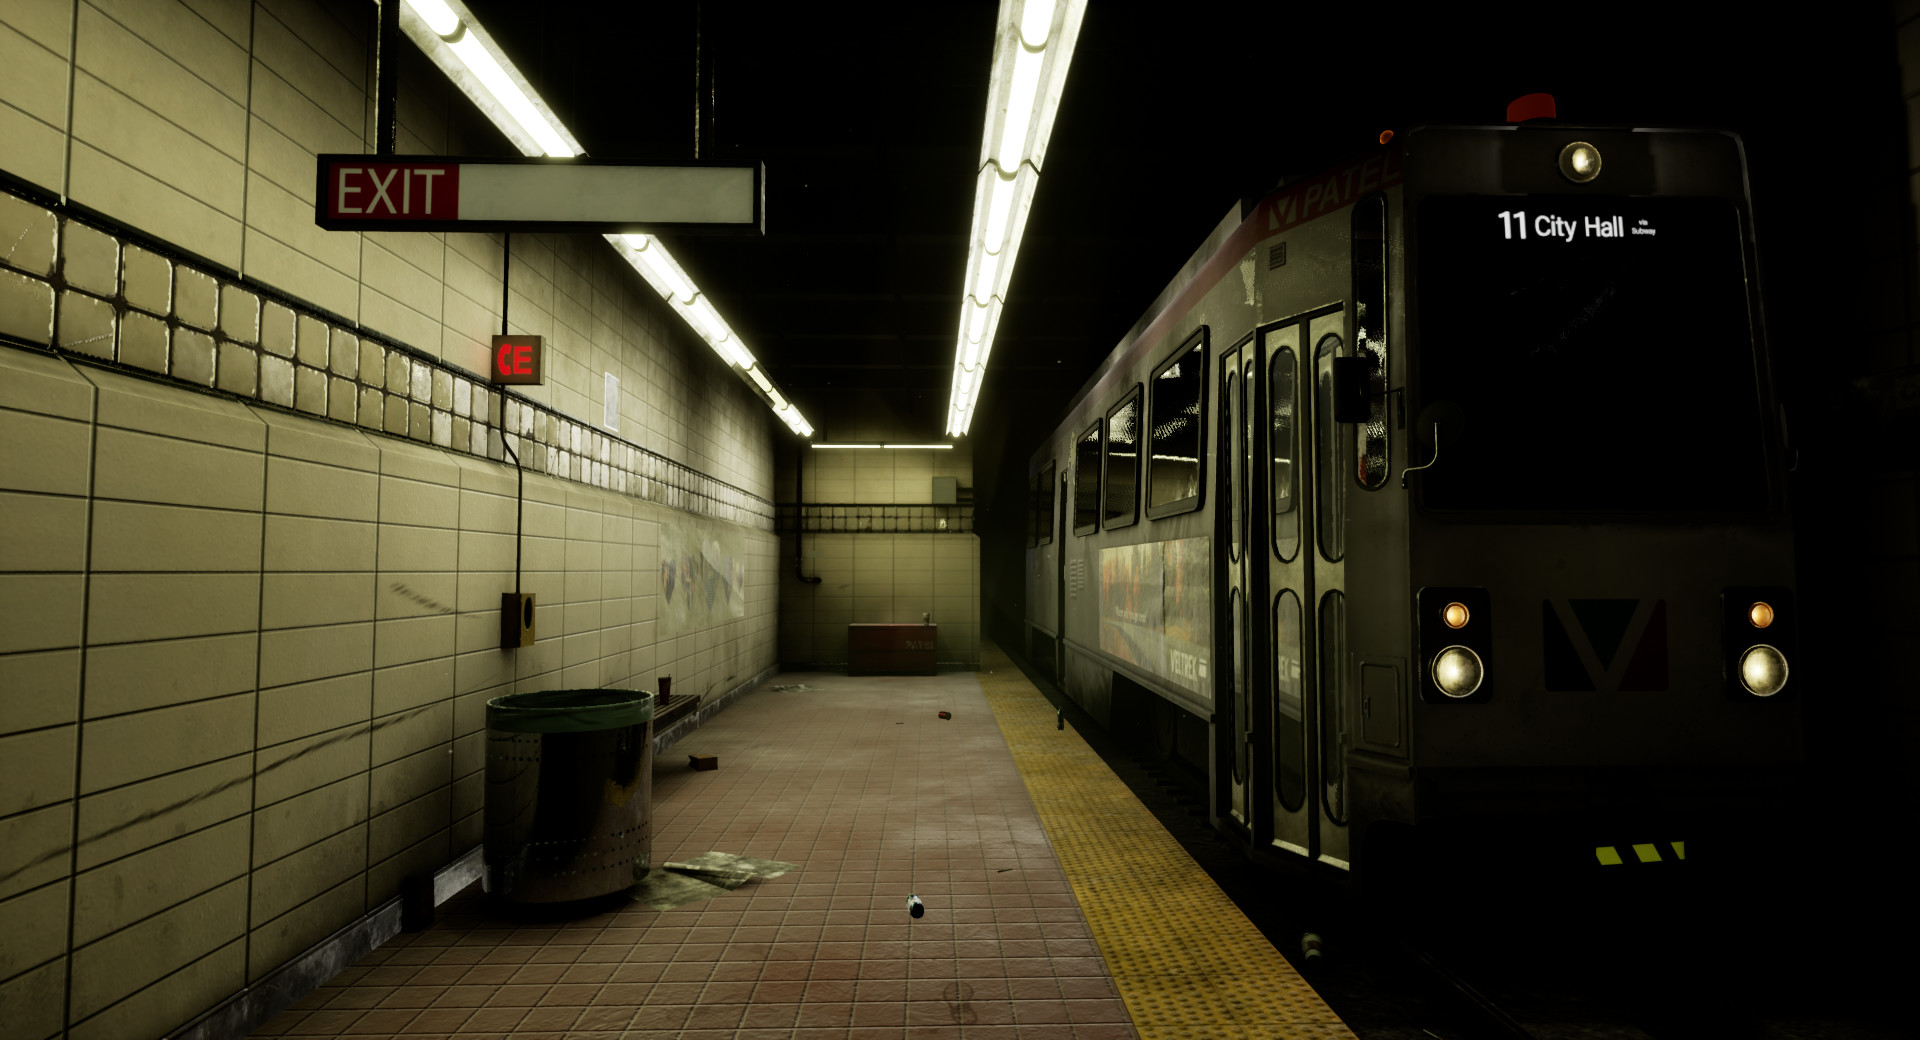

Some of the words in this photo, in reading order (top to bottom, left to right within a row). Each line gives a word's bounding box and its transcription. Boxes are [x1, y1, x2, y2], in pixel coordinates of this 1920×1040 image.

[337, 167, 446, 215] EXIT
[1302, 149, 1400, 219] PATEL
[1497, 210, 1528, 240] 11
[1534, 214, 1578, 243] City
[1584, 214, 1625, 239] Hall
[1631, 226, 1657, 237] Subway
